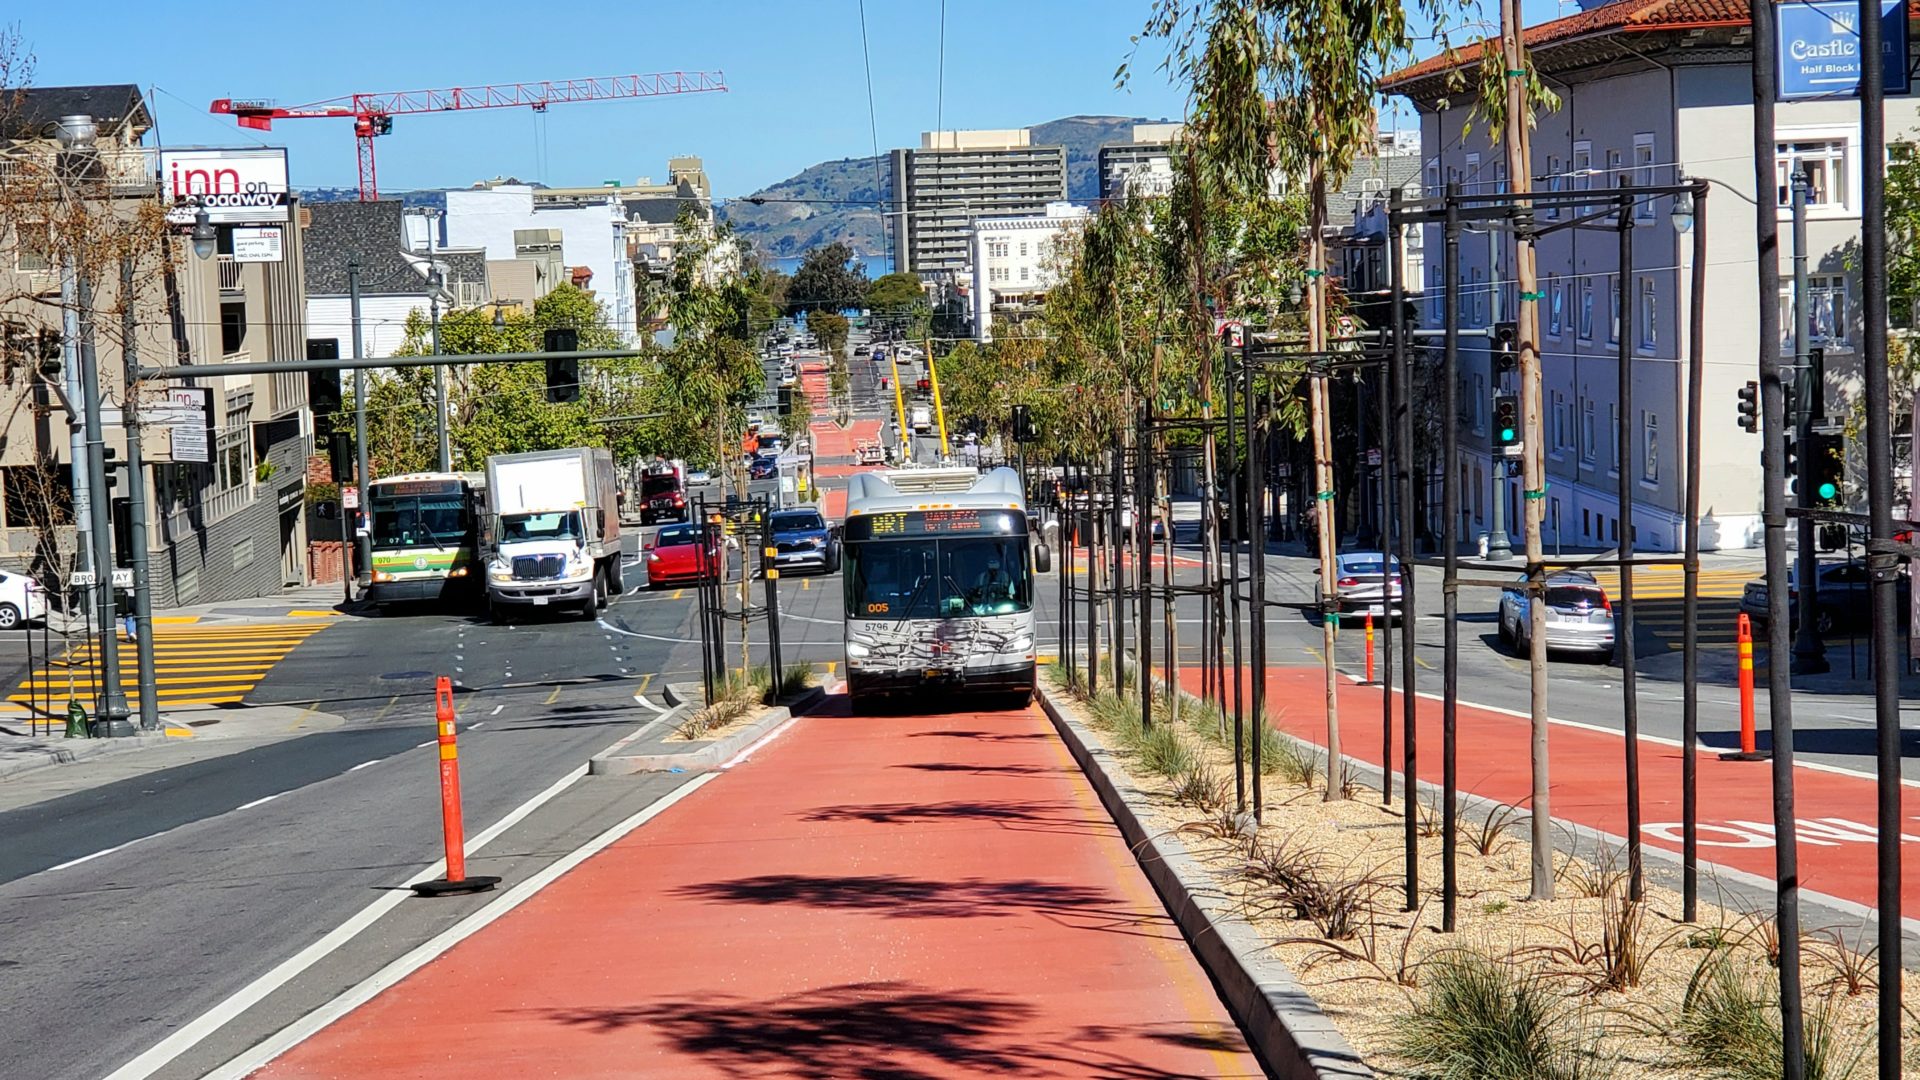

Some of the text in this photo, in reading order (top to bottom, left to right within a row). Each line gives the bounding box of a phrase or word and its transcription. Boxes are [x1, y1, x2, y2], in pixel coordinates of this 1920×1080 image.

[1790, 39, 1855, 61] Castle
[1801, 65, 1822, 74] Half
[1825, 64, 1854, 73] Block
[172, 162, 268, 196] inn on
[185, 191, 281, 209] boadway
[260, 228, 278, 238] free
[173, 390, 191, 405] inn
[74, 574, 128, 583] BROAY
[867, 603, 889, 613] 005
[865, 623, 889, 632] 5796
